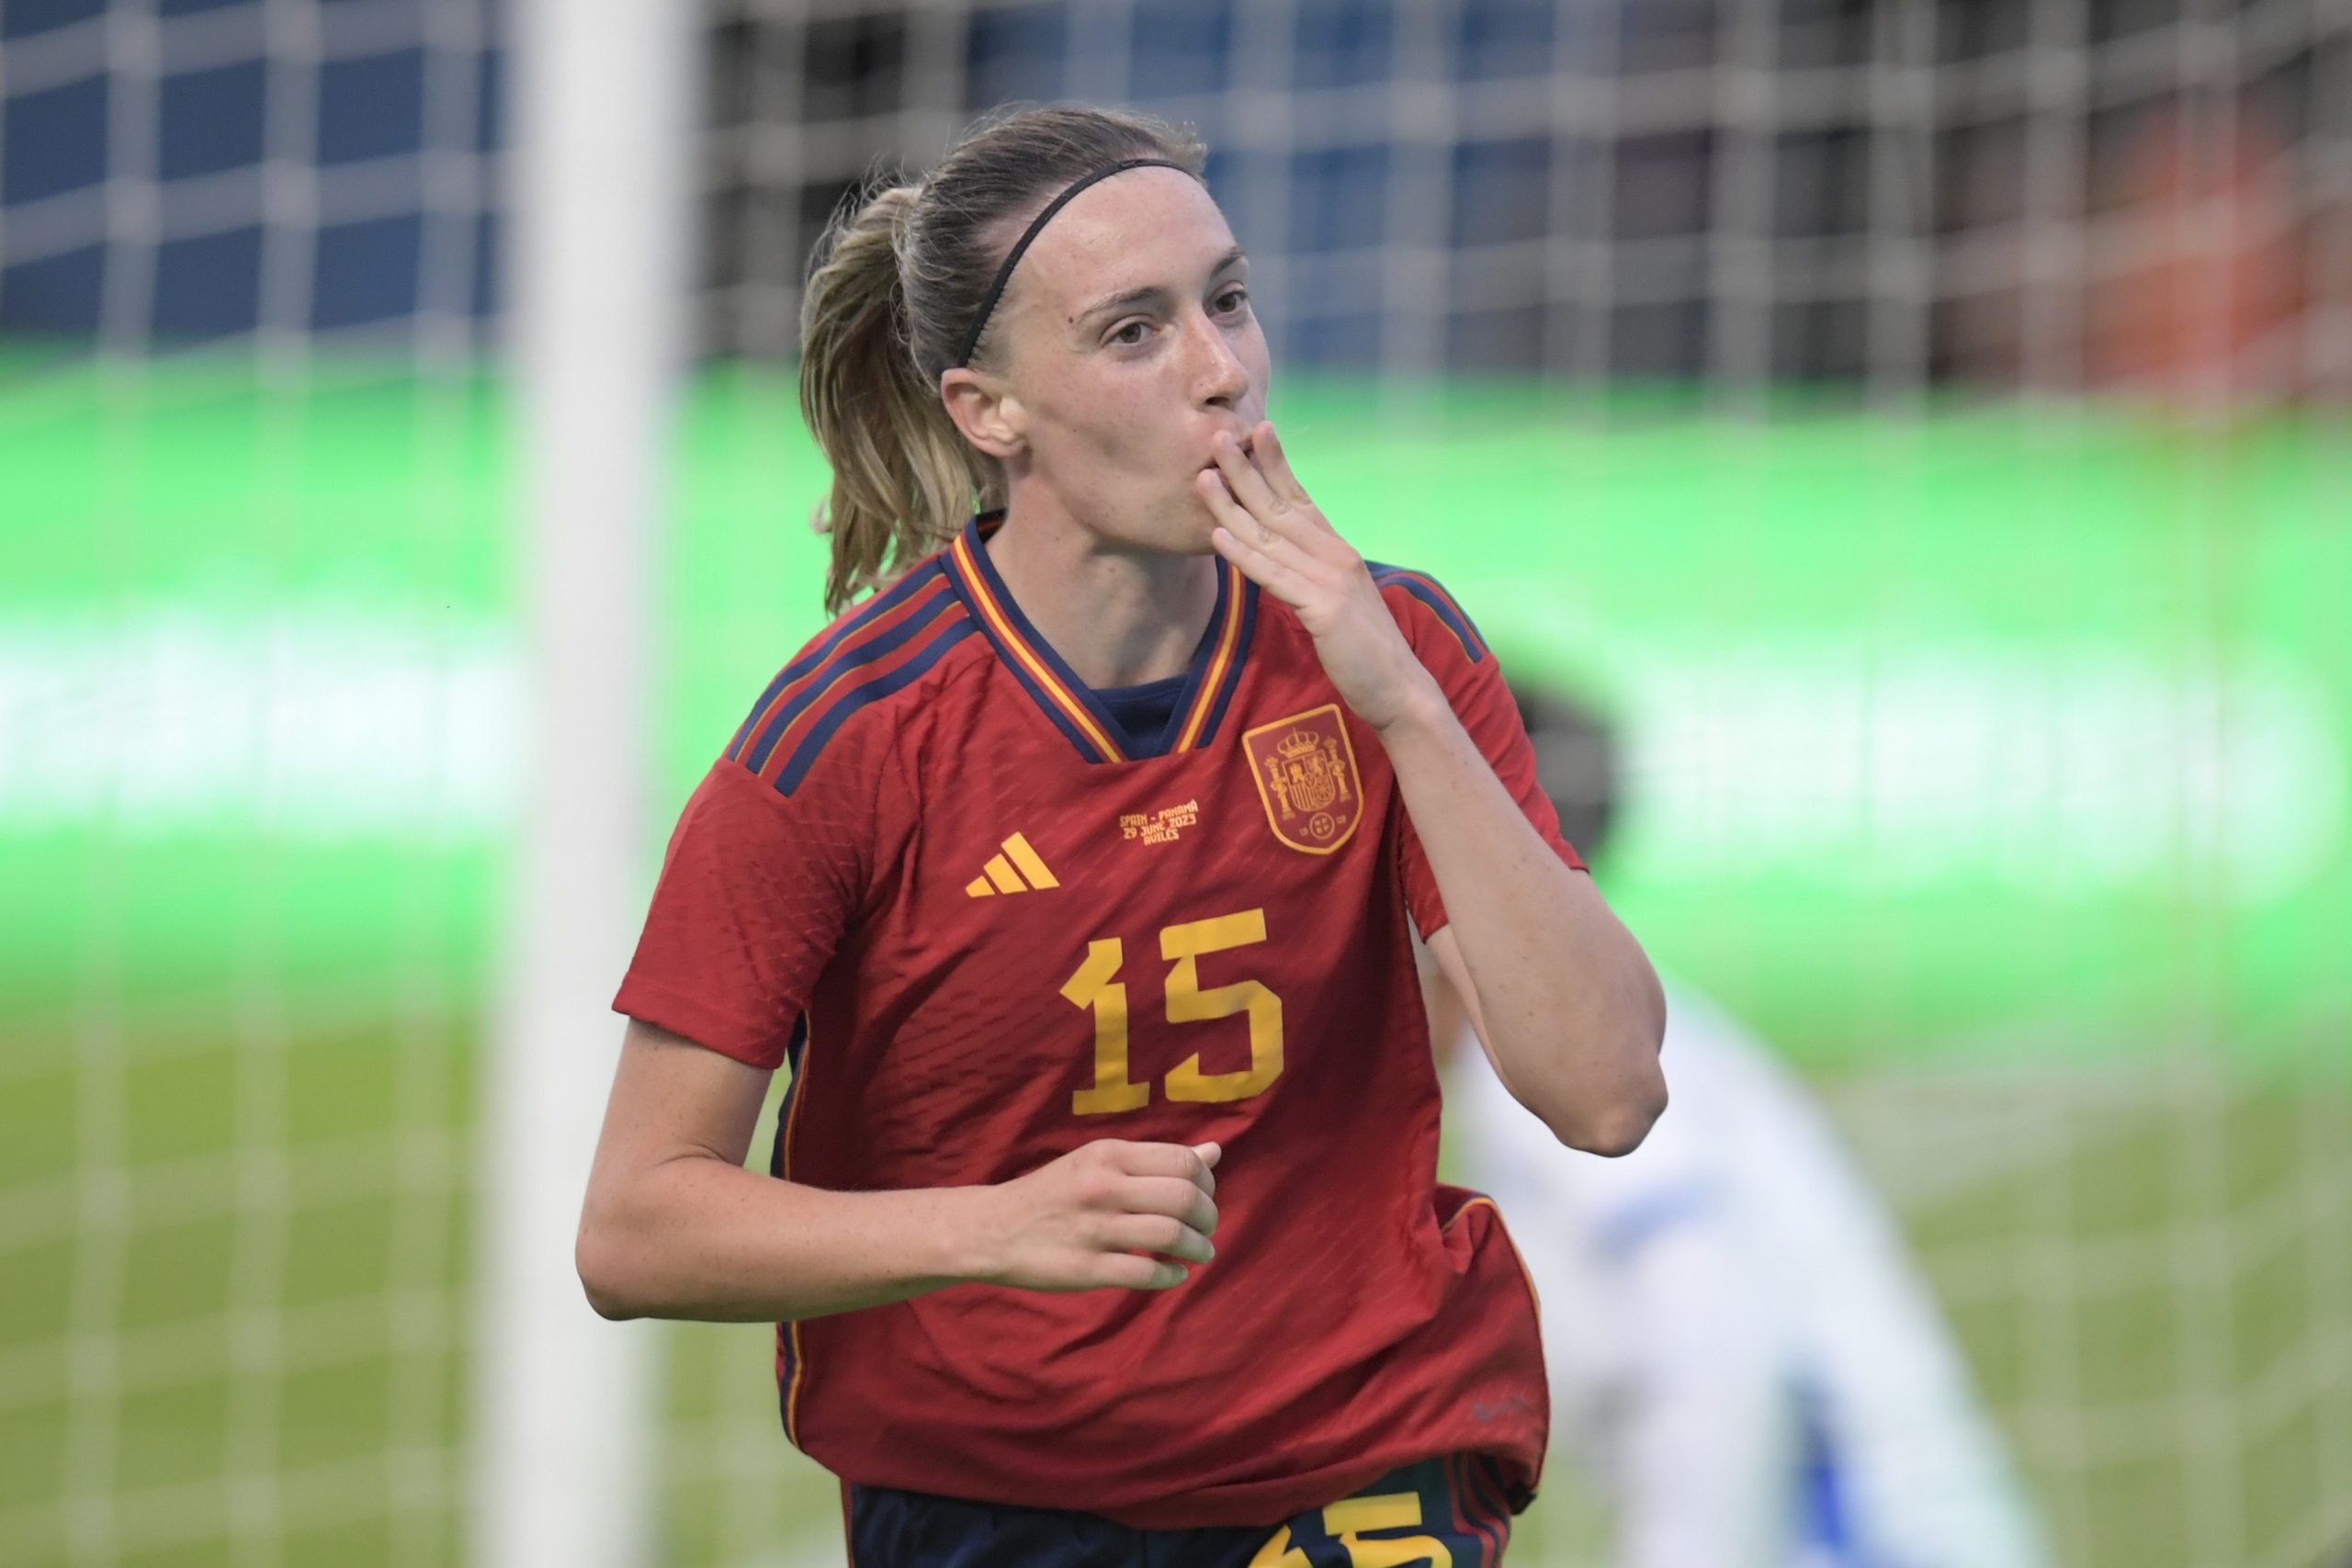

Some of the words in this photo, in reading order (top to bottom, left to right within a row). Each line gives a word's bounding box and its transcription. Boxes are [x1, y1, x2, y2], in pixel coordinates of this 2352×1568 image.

[1119, 814, 1147, 827] SPAIN
[1123, 827, 1136, 840] 29
[1139, 820, 1165, 836] JUNE
[1168, 813, 1196, 828] 2023
[1059, 908, 1283, 1115] 15
